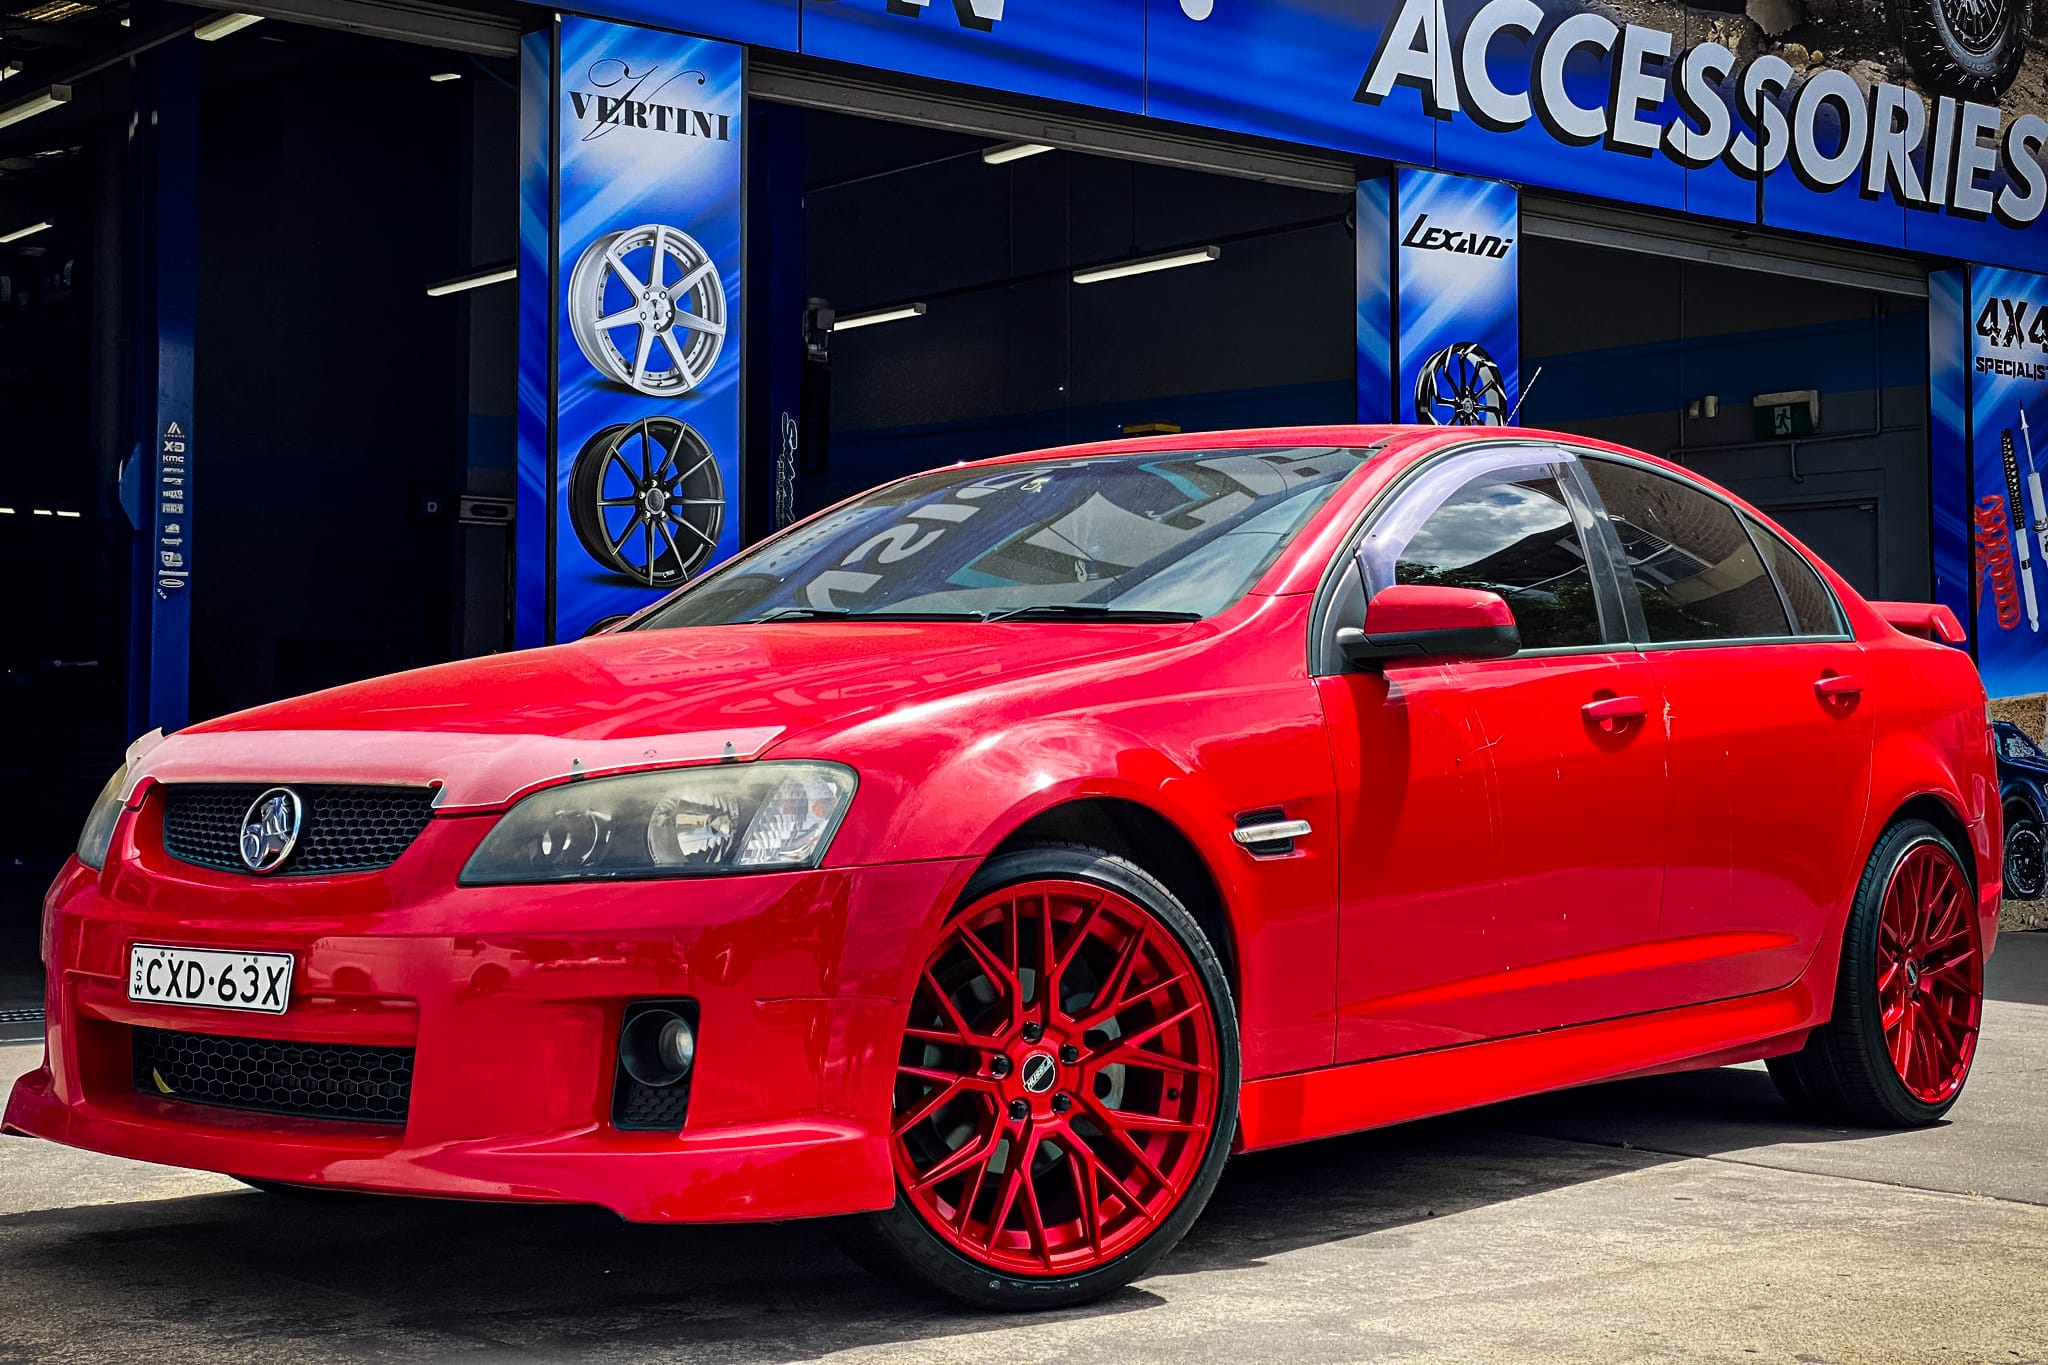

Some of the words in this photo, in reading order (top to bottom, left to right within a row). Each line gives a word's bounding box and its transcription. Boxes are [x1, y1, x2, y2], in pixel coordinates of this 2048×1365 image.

[568, 91, 731, 142] VERTINI
[1363, 0, 2048, 223] ACCESSORIES
[1976, 297, 2048, 354] 4X4
[1975, 356, 2048, 382] SPECIALIS
